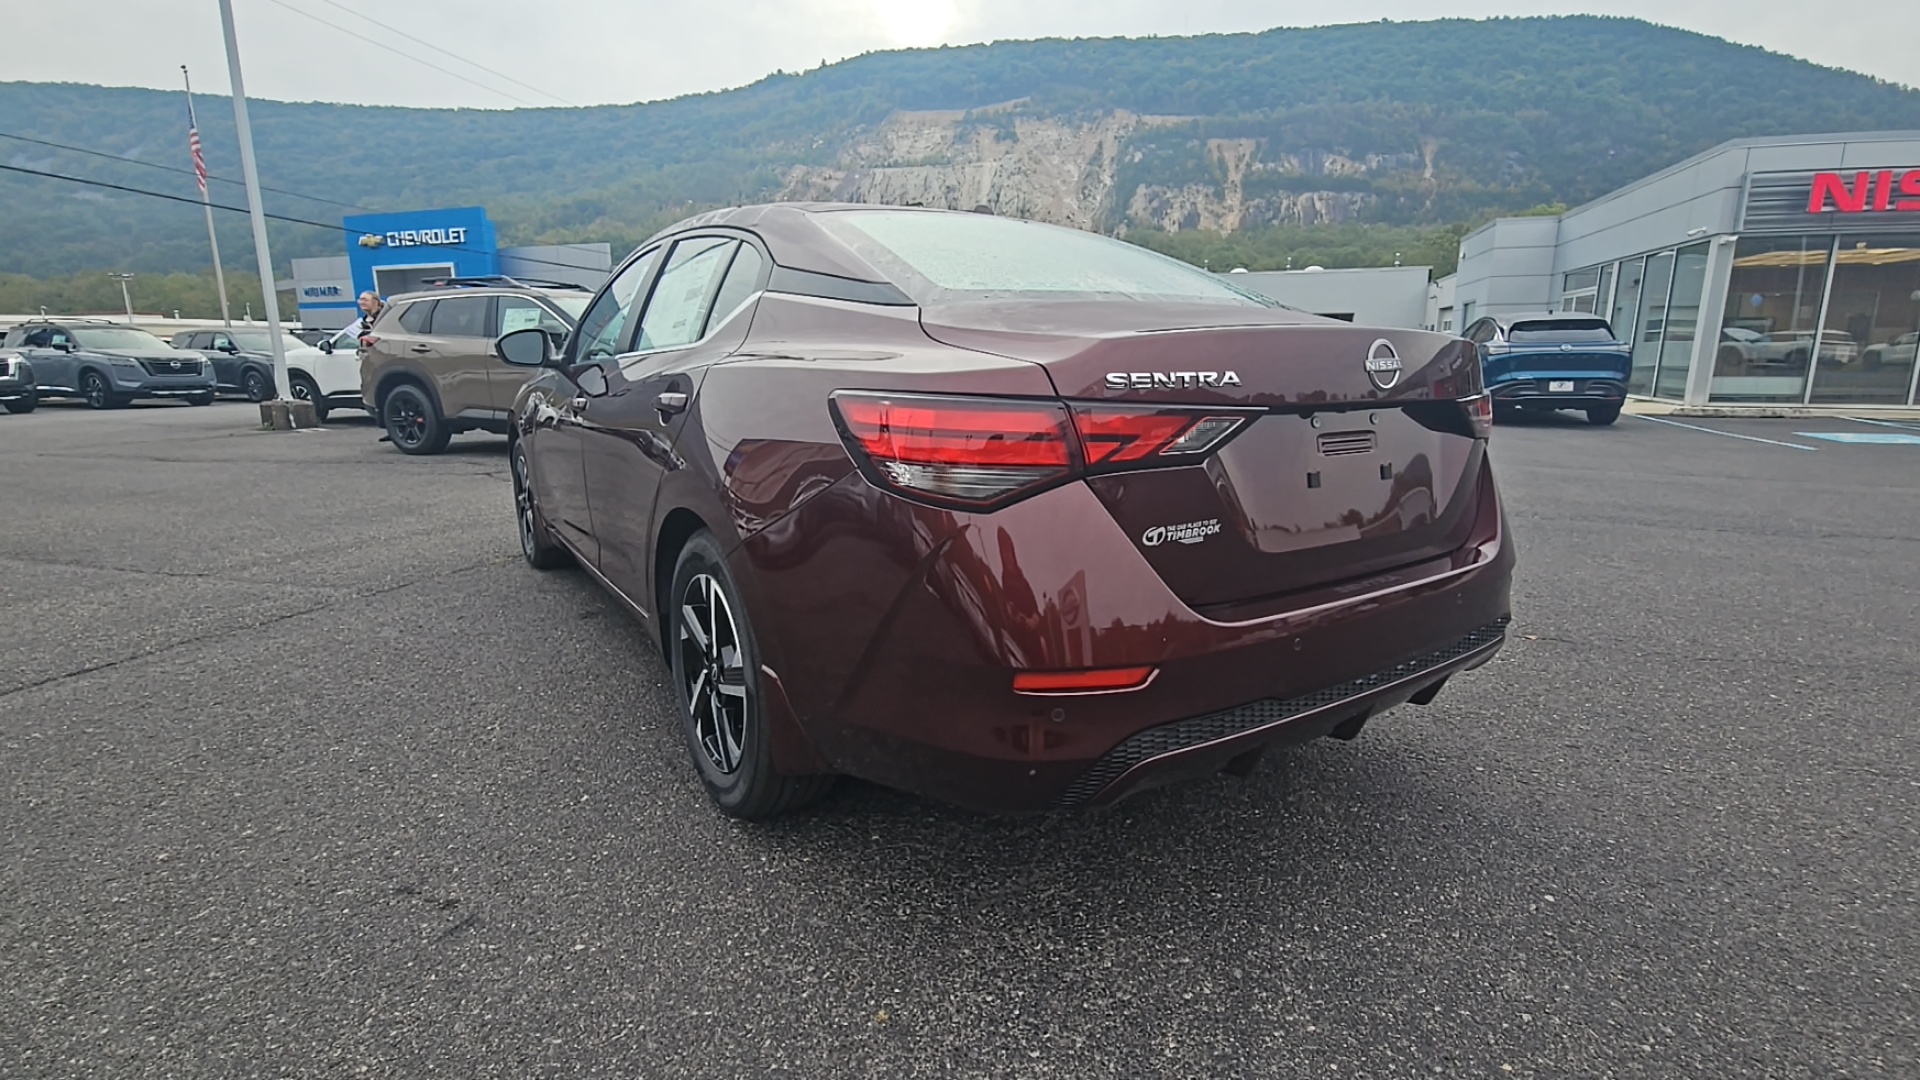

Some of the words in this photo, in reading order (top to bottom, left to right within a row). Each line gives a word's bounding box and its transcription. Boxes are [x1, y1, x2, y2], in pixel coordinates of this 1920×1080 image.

[386, 227, 467, 247] CHEVROLET
[1105, 371, 1242, 389] SENTRA
[1167, 523, 1221, 541] TIMBROOK
